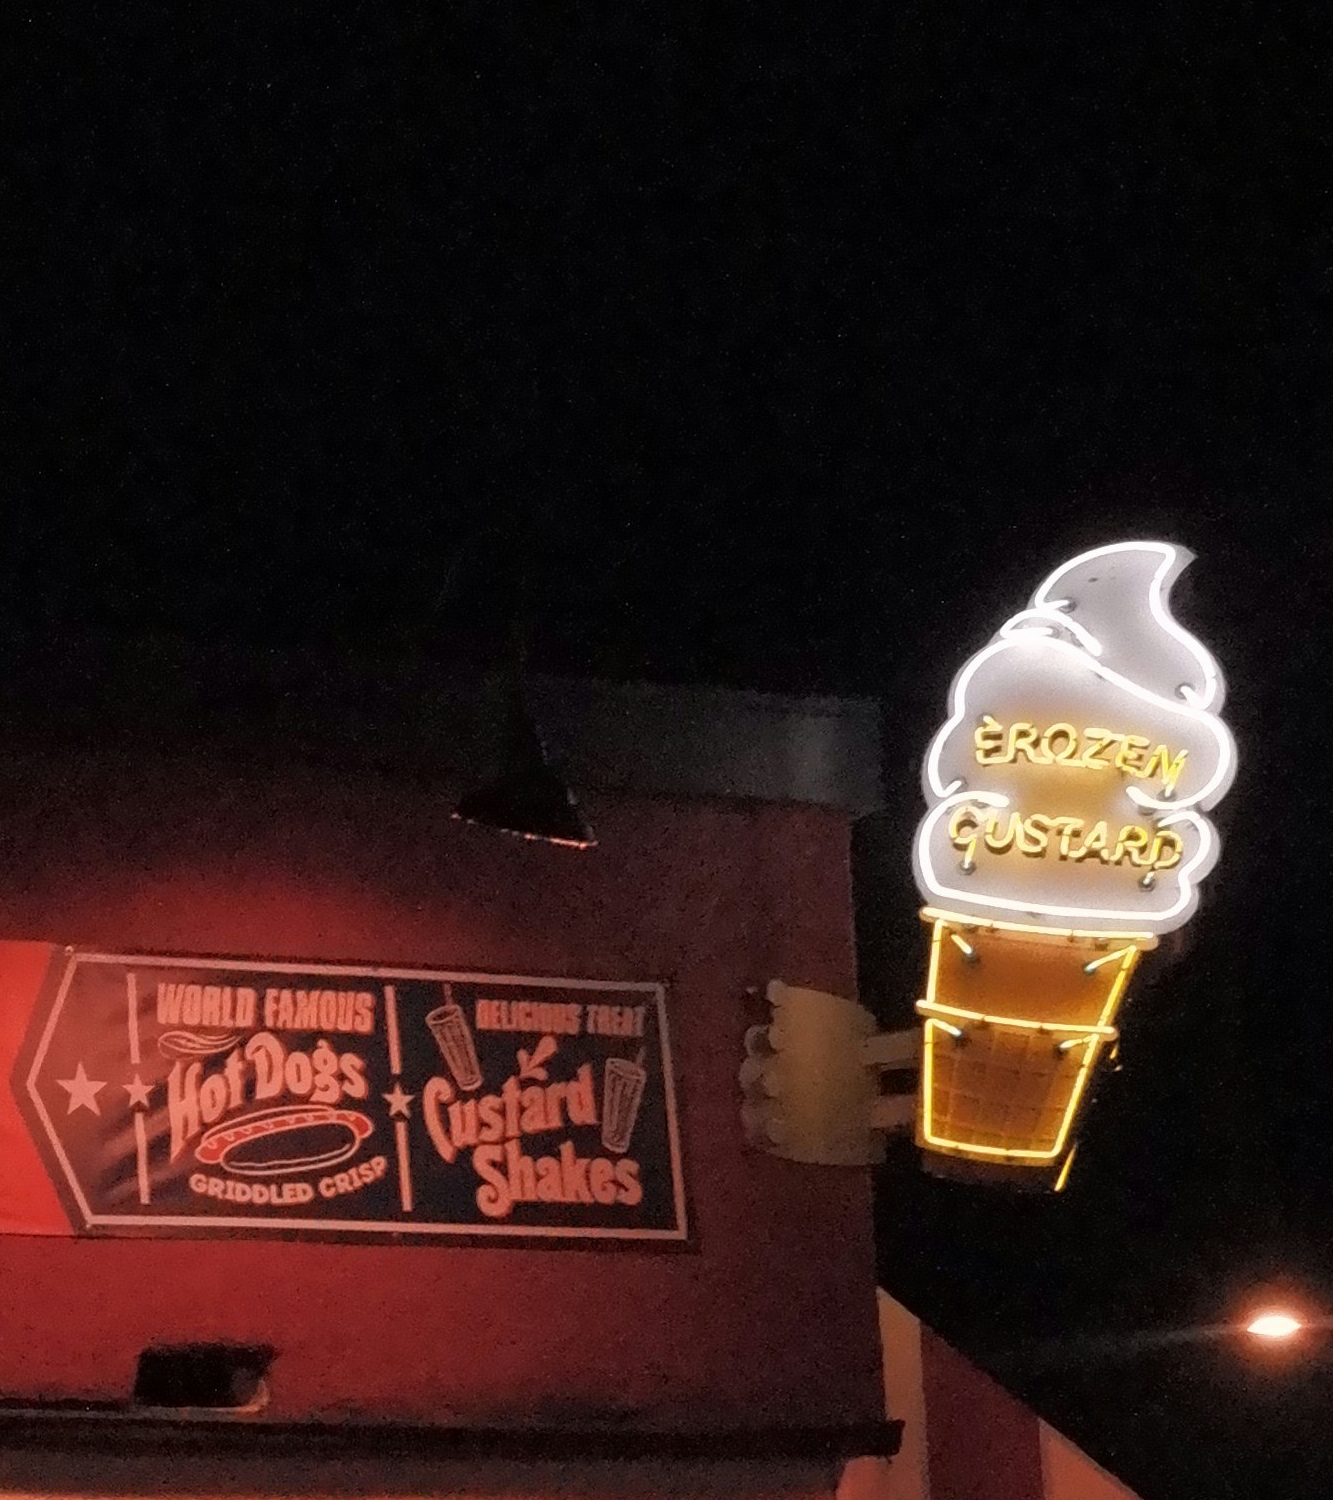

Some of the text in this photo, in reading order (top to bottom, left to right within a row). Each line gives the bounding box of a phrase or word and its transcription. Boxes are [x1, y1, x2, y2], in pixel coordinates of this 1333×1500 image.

[974, 719, 1189, 790] FROZEN
[949, 806, 1183, 868] CUSTARD
[156, 983, 375, 1035] WORLD FAMOUS
[167, 1032, 369, 1164] Hot Dogs
[423, 1063, 599, 1164] Custard
[189, 1156, 388, 1205] GRIDDLED CRISP
[472, 1138, 643, 1218] Shakes
